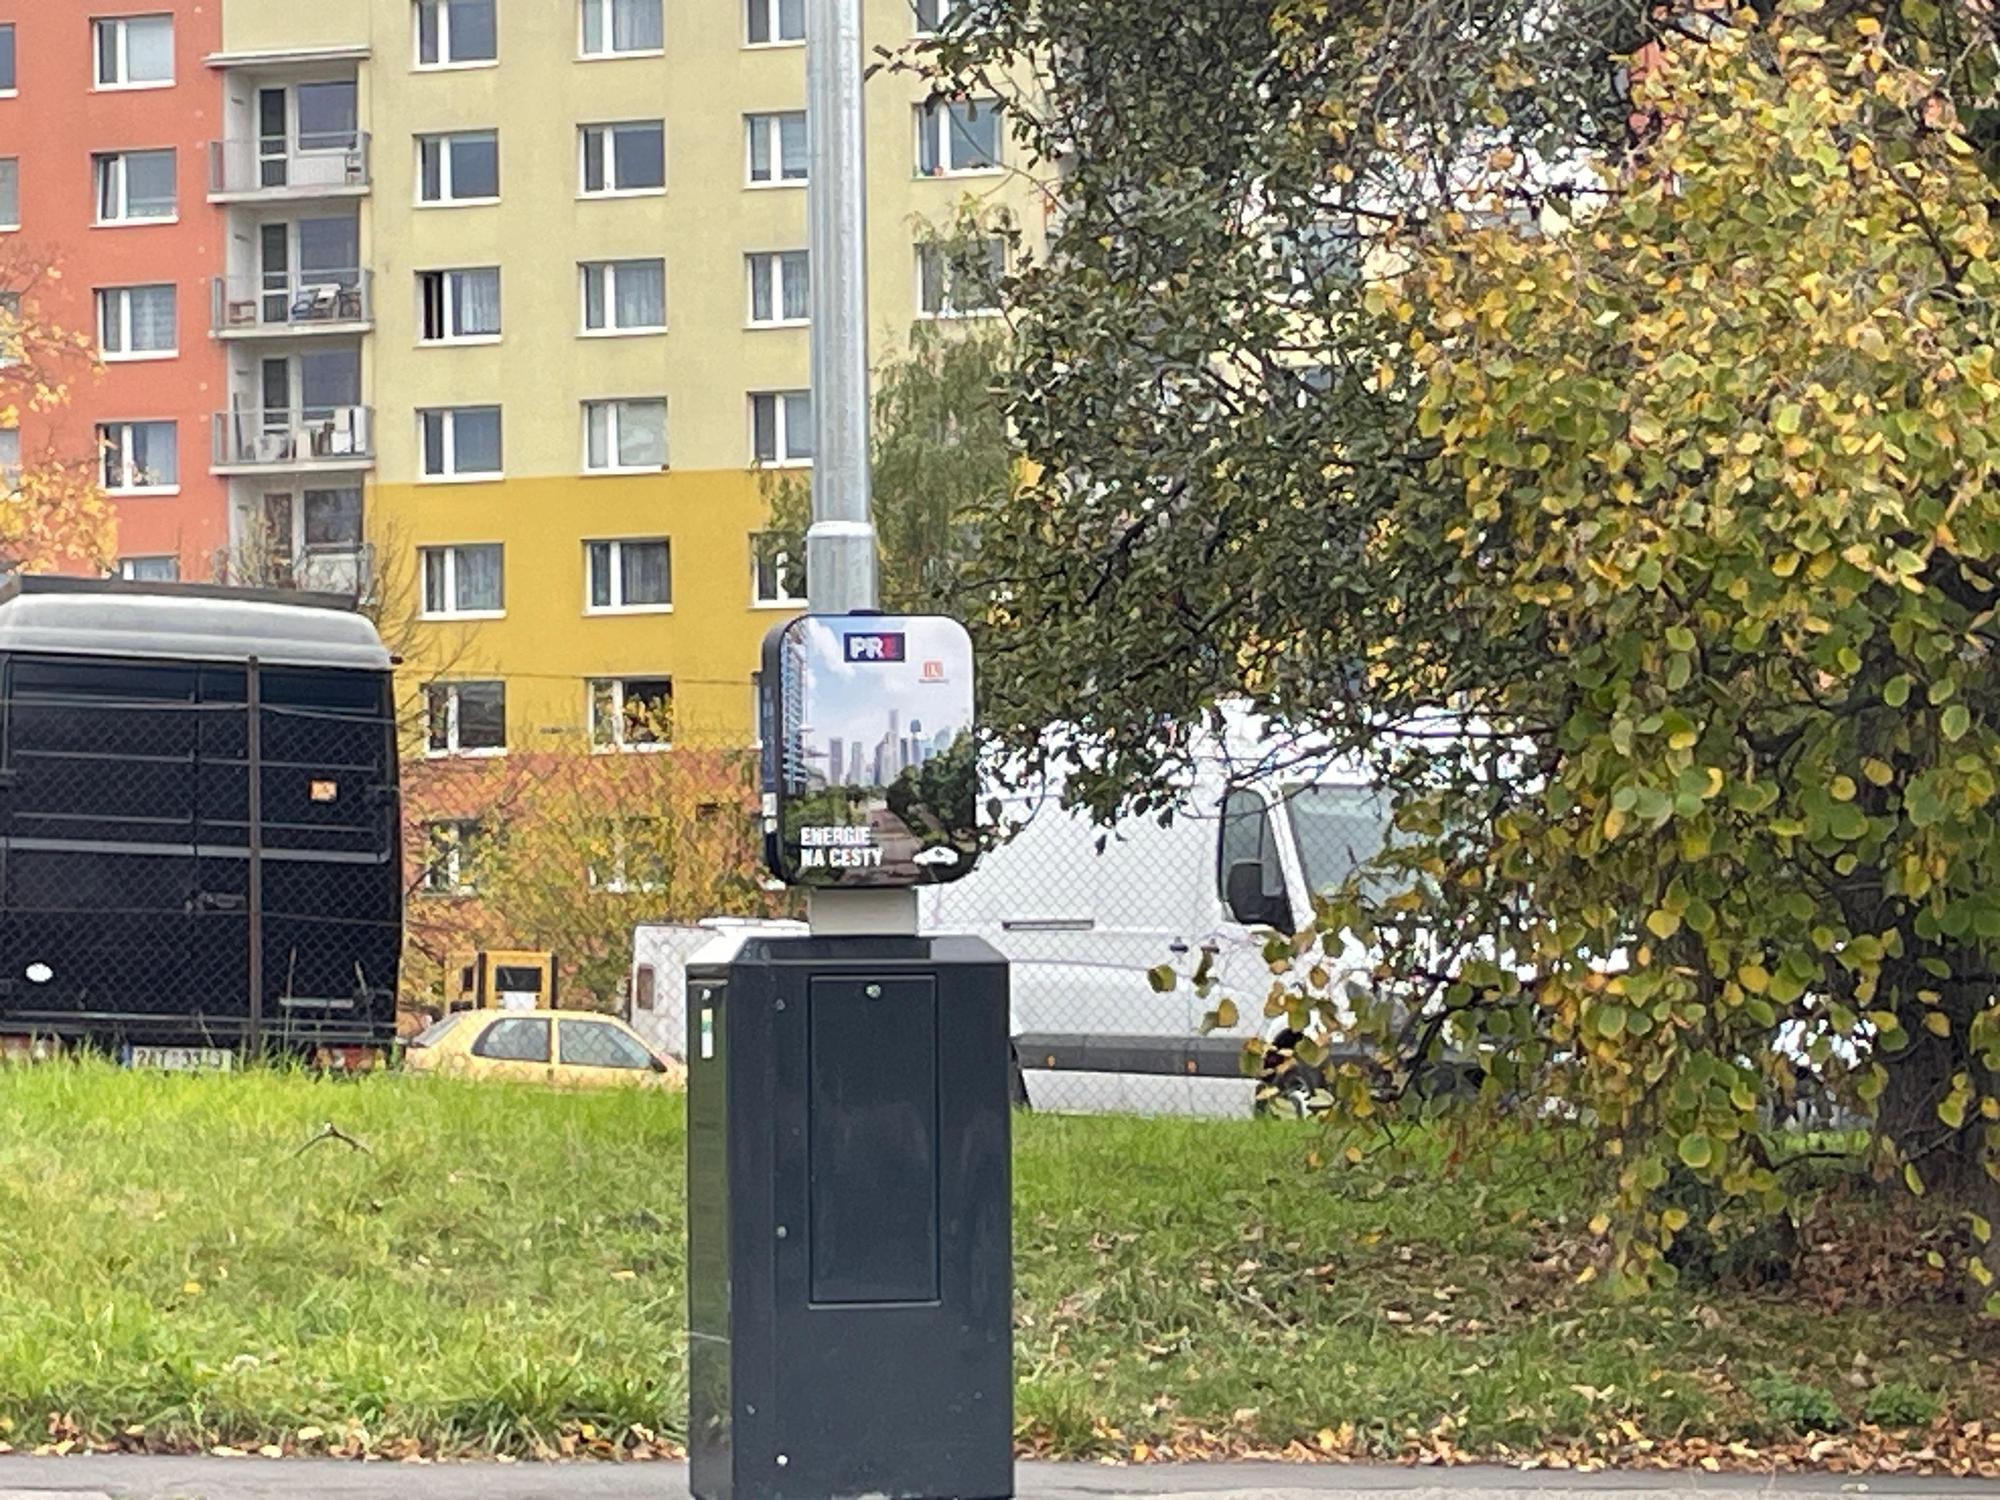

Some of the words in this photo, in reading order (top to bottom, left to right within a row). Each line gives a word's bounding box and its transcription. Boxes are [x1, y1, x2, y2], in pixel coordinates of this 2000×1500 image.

[800, 826, 871, 846] ENERGIE
[800, 848, 826, 867] NA
[829, 848, 884, 867] CESTY
